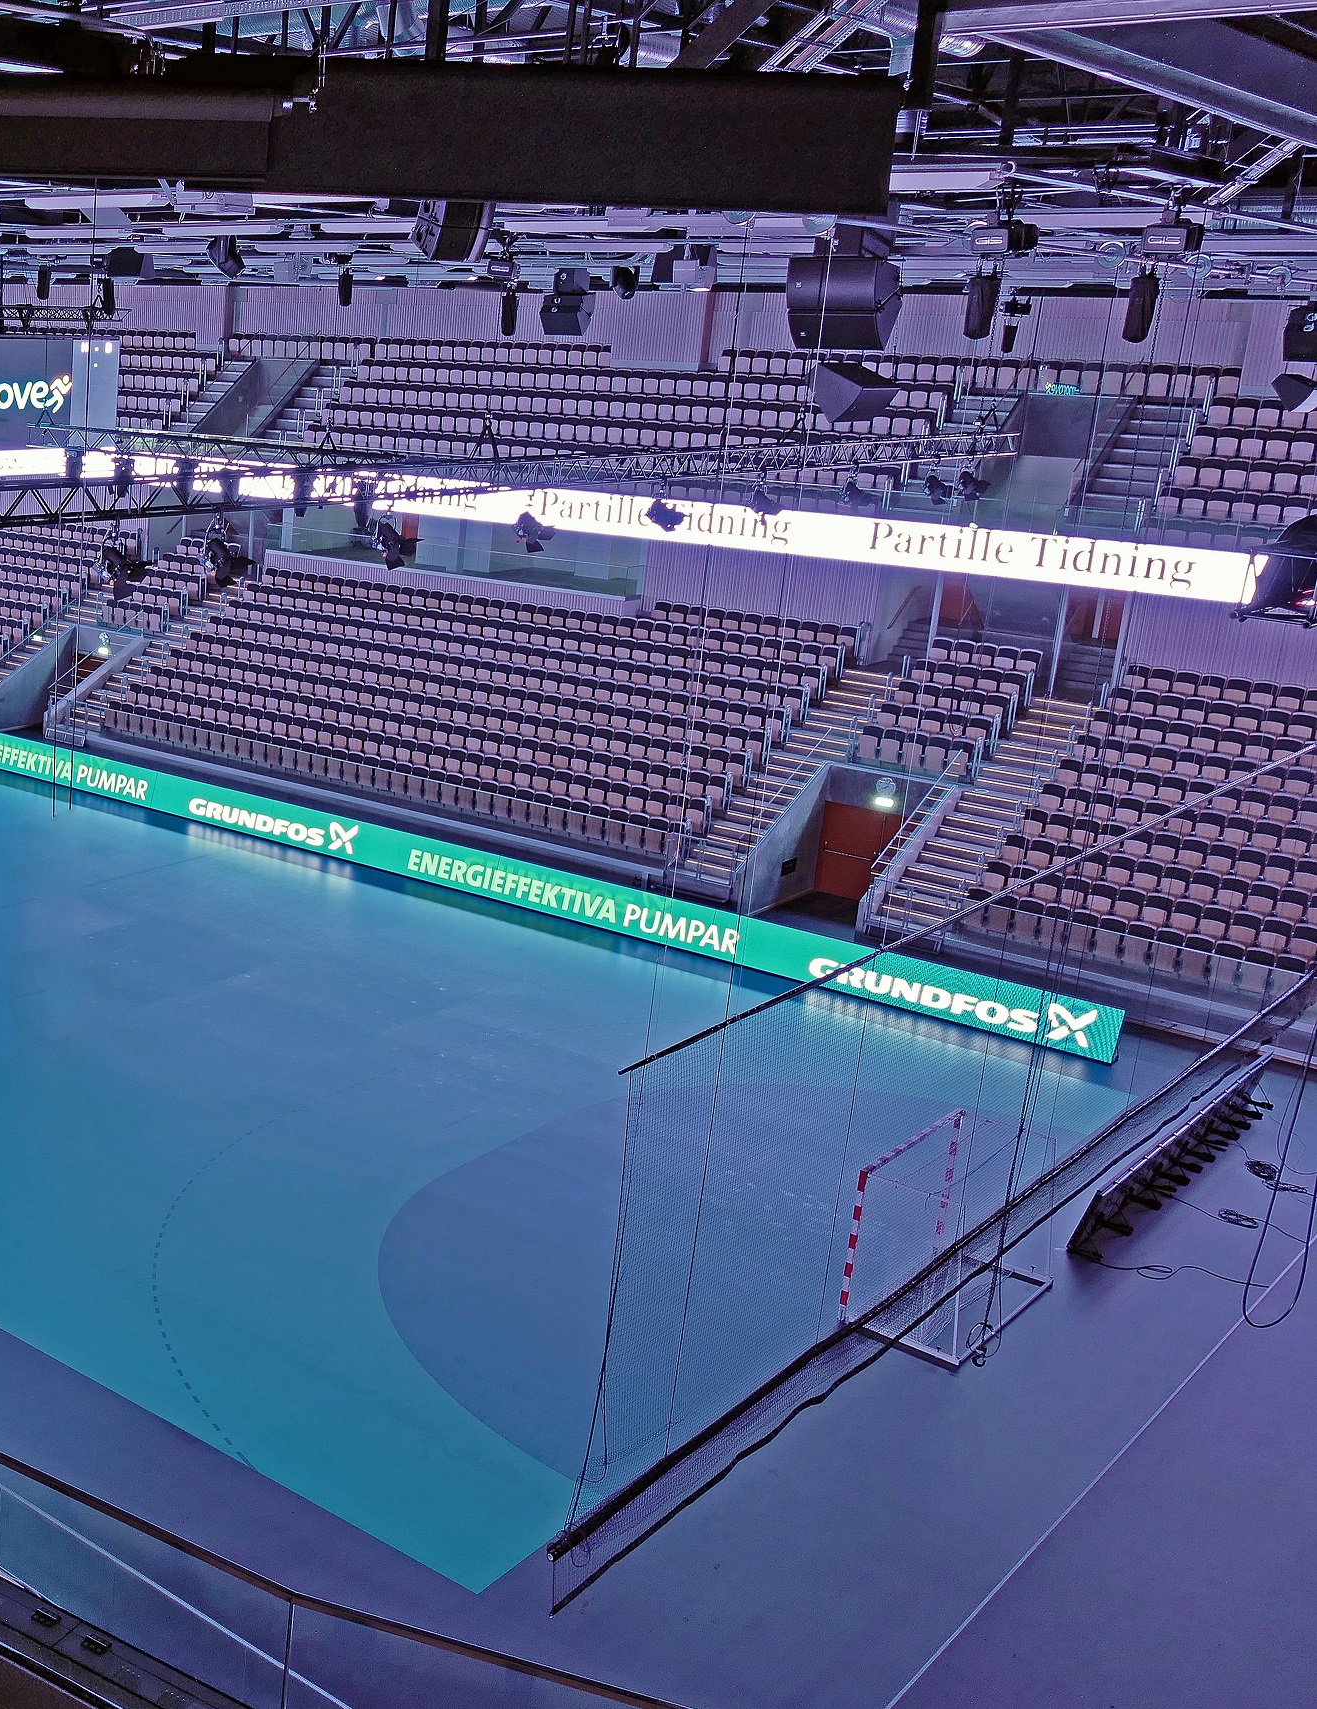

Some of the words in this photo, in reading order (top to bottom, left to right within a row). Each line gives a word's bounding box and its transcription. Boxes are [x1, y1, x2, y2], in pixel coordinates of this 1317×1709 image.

[974, 236, 1003, 246] GIS
[1147, 235, 1181, 246] GIS
[540, 490, 654, 527] Partille
[670, 502, 792, 546] idning
[869, 521, 1014, 564] Partille
[1030, 535, 1197, 590] Tidning
[76, 763, 149, 801] PUMPAR
[188, 797, 325, 847] GRUNDFOS
[407, 847, 617, 925] ENERGIEFFEKTIVA
[623, 902, 741, 955] PUMPAR
[808, 957, 1041, 1034] GRUNDFOS
